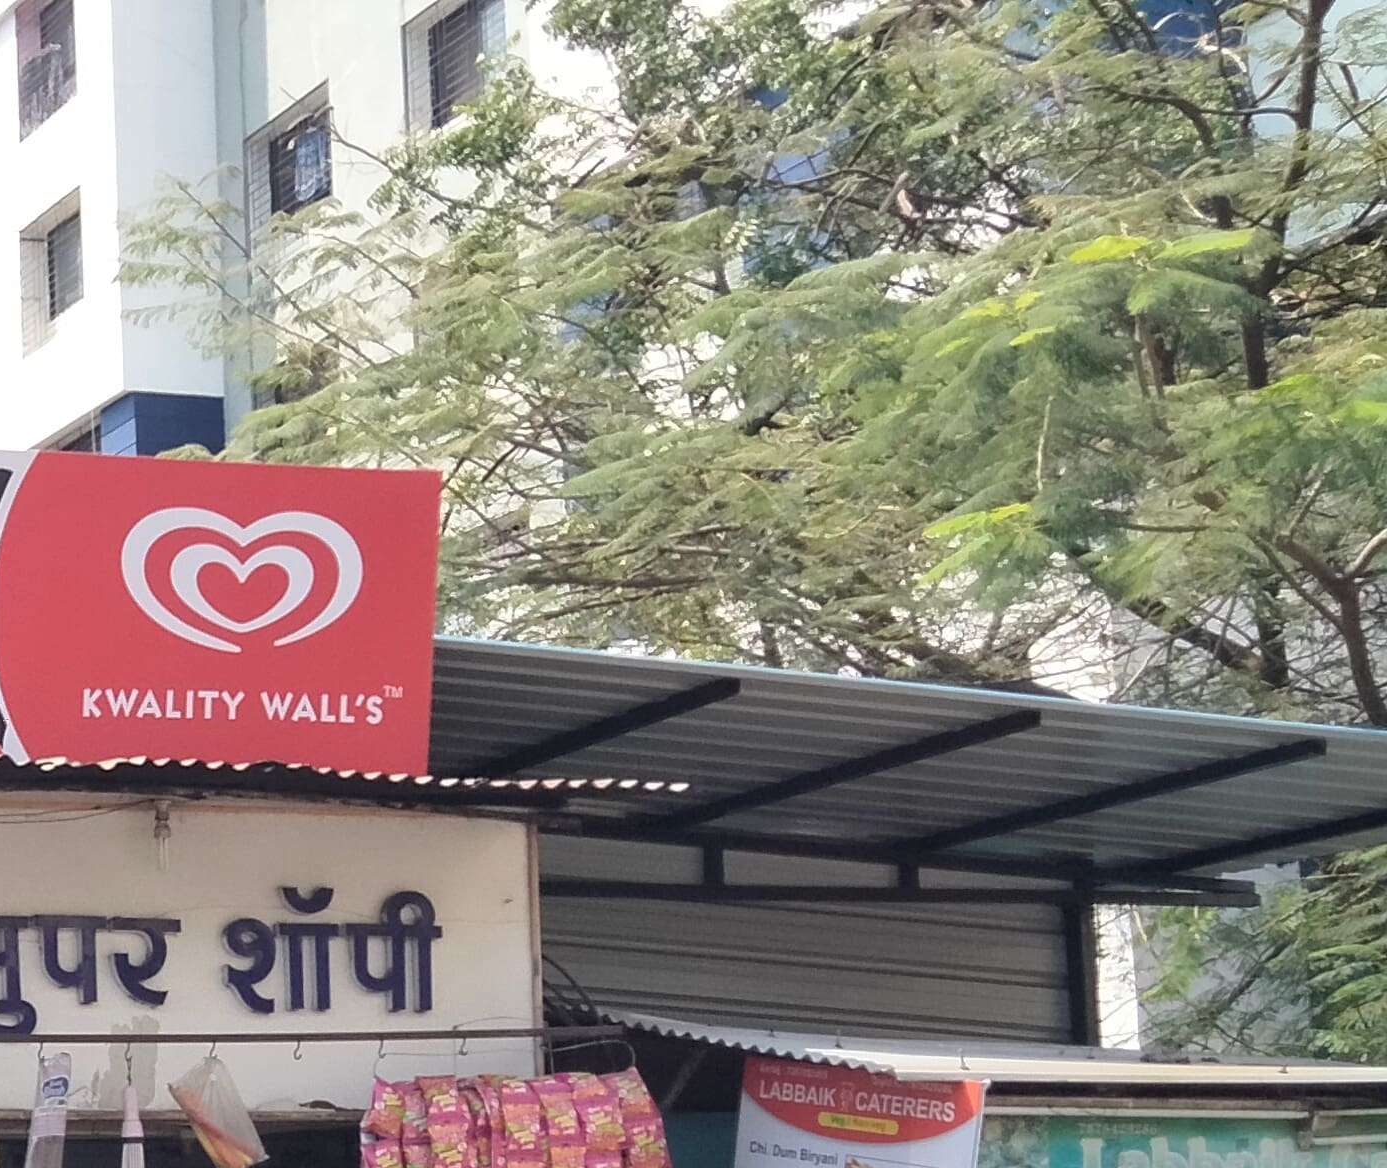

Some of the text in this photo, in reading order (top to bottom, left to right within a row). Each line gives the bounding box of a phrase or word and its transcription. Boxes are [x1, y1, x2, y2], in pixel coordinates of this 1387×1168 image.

[81, 687, 244, 721] KWALITY
[260, 691, 384, 726] WALL'S
[220, 886, 442, 1013] शॉपी
[758, 1079, 836, 1108] LABBAIK
[855, 1091, 956, 1123] CATERERS
[772, 1144, 797, 1159] Dum
[800, 1148, 839, 1167] Biryani
